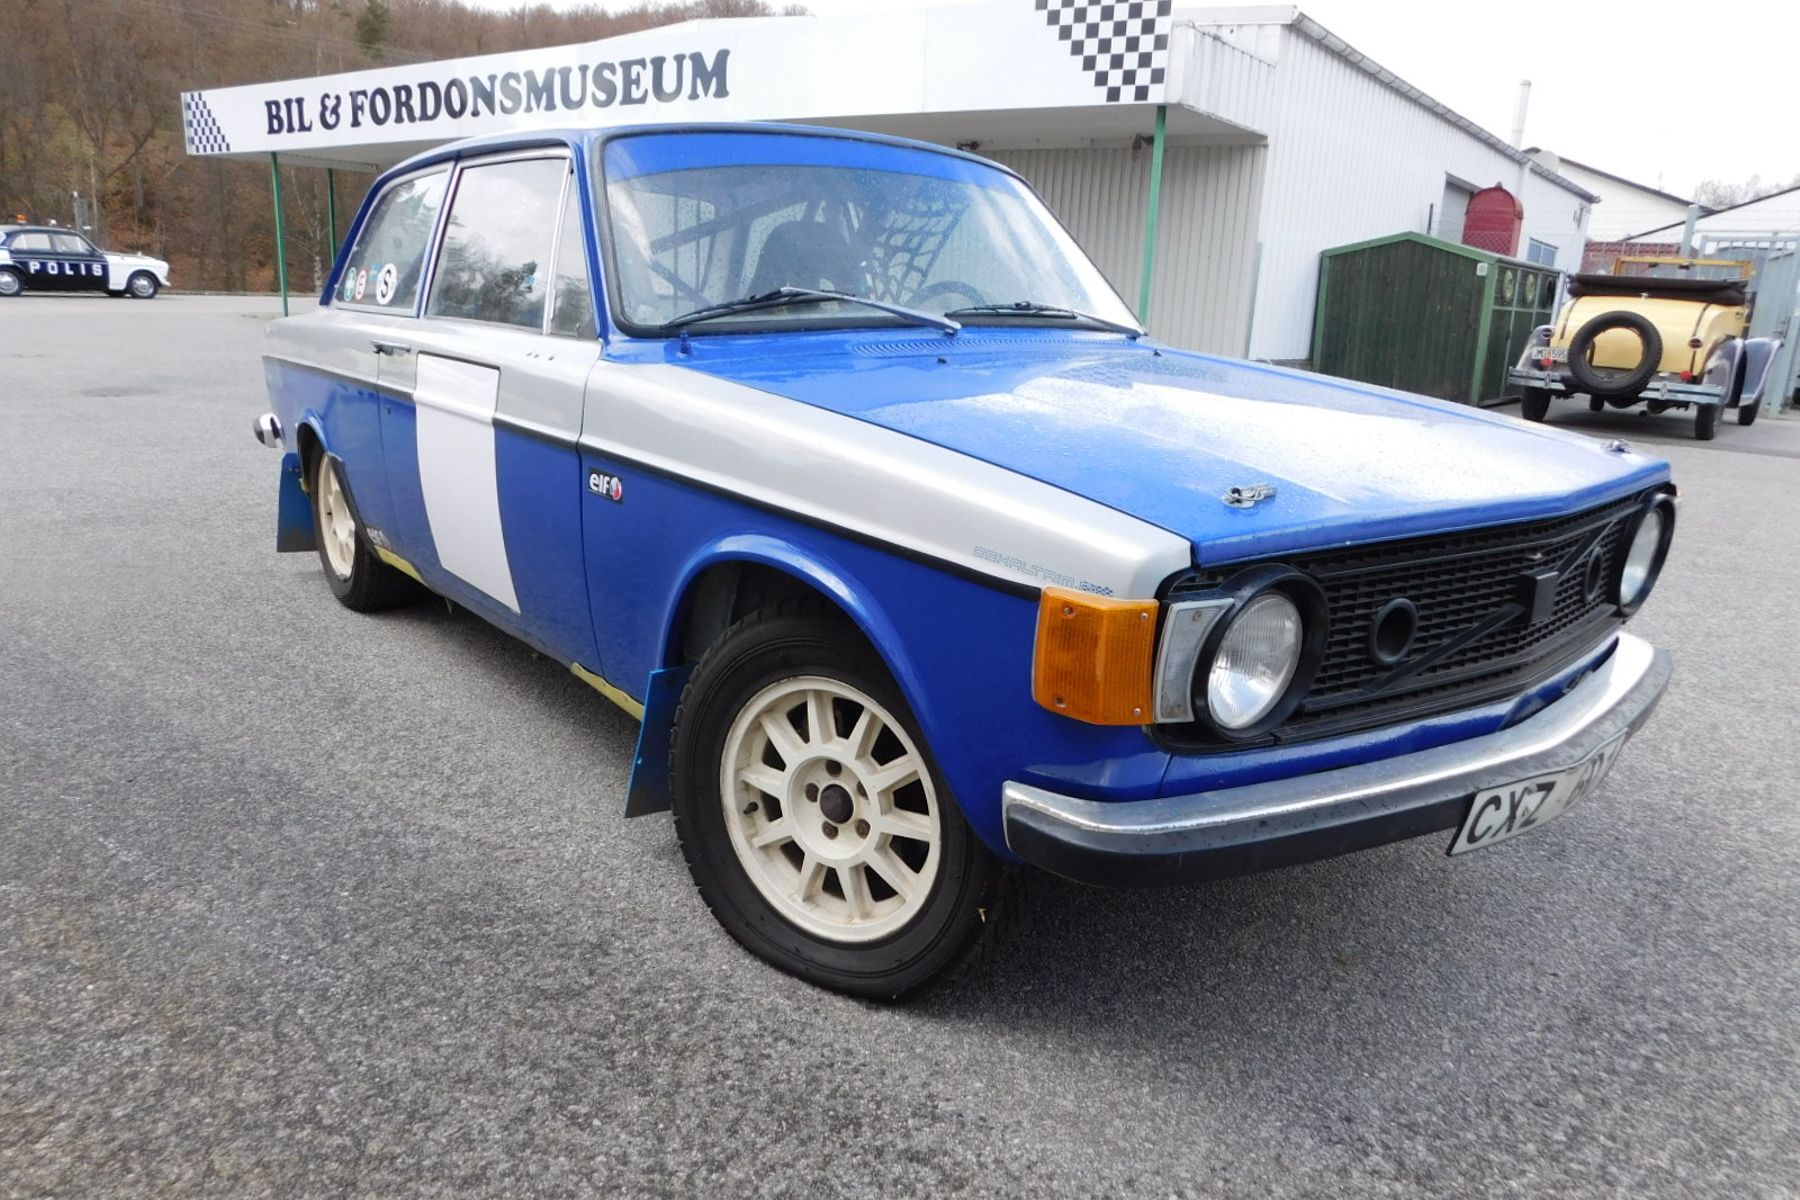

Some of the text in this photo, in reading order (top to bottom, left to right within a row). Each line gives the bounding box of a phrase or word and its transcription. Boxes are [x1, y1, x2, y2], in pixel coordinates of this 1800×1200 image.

[265, 48, 730, 134] BIL & FORDONSMUSEUM
[29, 261, 103, 276] POLIS
[380, 268, 391, 299] S
[589, 473, 610, 494] elf
[1466, 781, 1557, 844] CXZ
